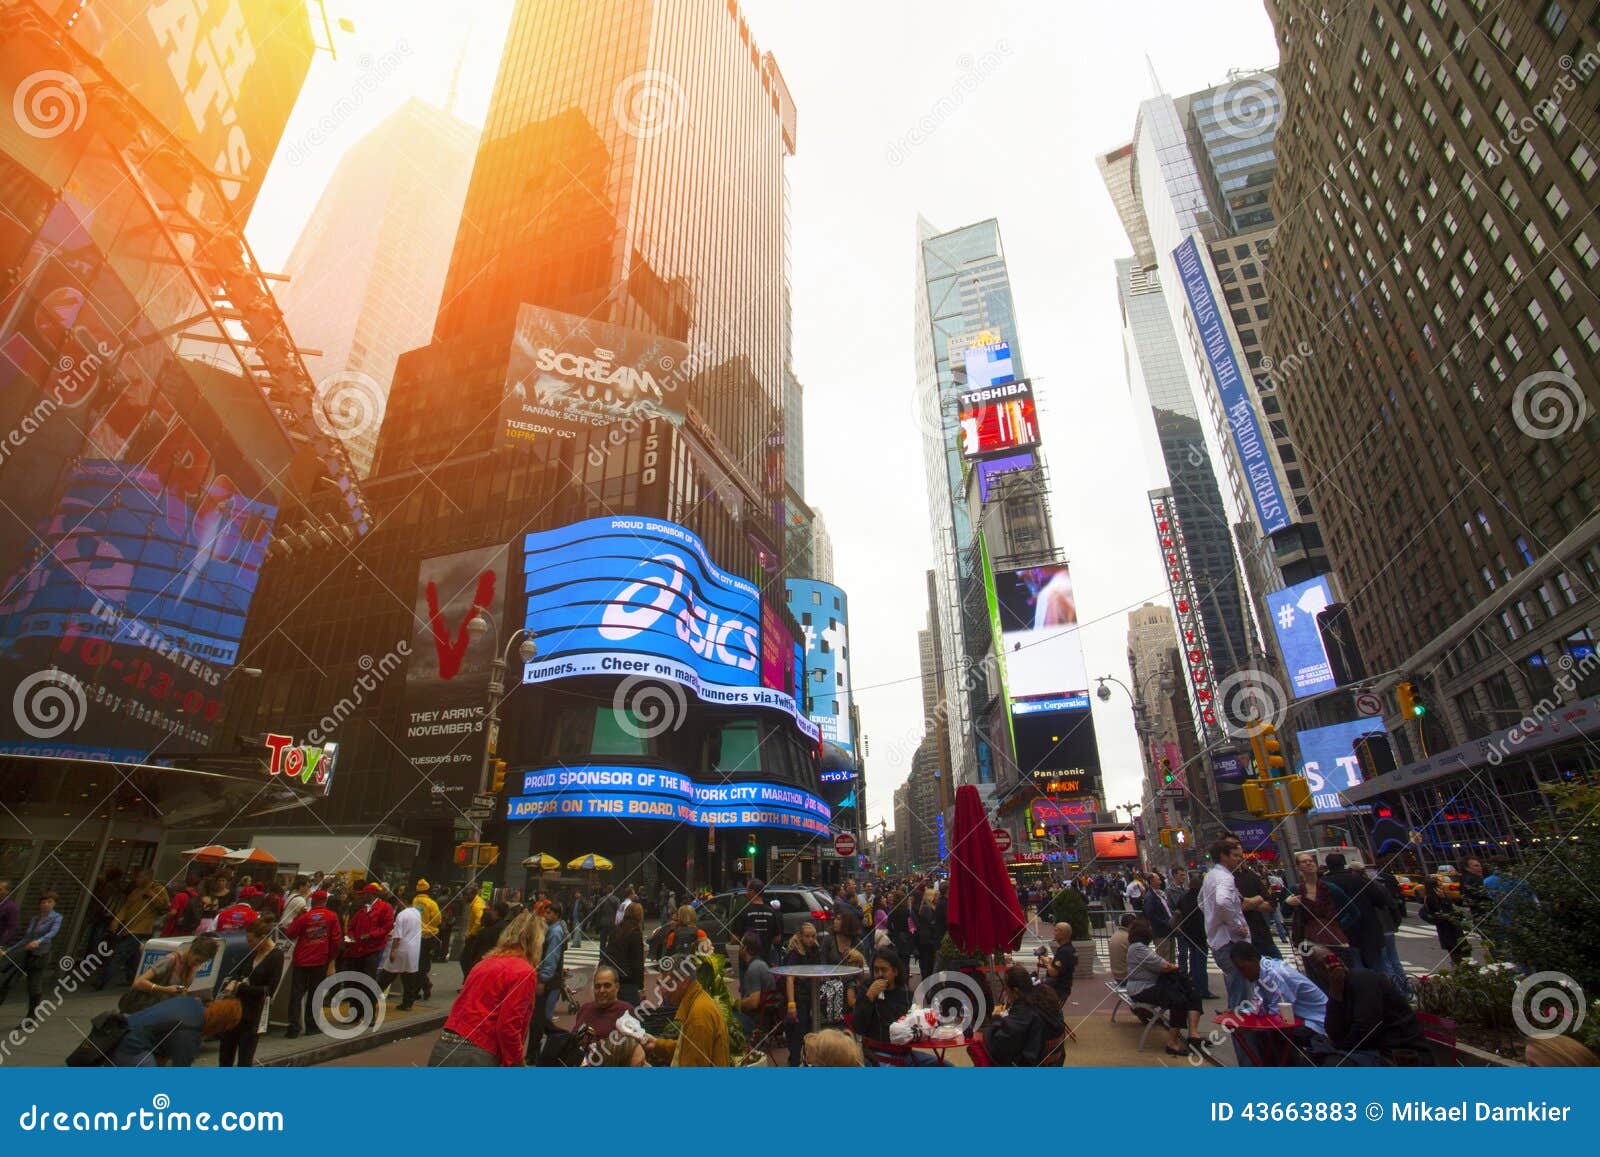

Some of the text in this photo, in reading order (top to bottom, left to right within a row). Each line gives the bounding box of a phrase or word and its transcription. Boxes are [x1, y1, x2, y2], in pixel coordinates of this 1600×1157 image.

[536, 348, 664, 399] SCREAM
[961, 383, 1028, 404] TOSHIBA
[506, 429, 535, 441] 10PM
[507, 420, 554, 434] TUESDAY
[642, 418, 658, 486] 1500
[612, 520, 644, 530] PROUD
[646, 522, 684, 540] SPONSOR
[425, 569, 496, 680] V
[528, 662, 576, 679] runners.
[601, 657, 650, 672] Cheer
[654, 664, 671, 676] on
[702, 686, 748, 702] runners
[754, 691, 771, 703] via
[1044, 699, 1087, 710] Corporation
[410, 711, 440, 723] THEY
[408, 721, 483, 737] NOVEMBER 3
[410, 754, 450, 765] TUESDAYS
[524, 773, 556, 789] PROUD
[560, 772, 632, 786] SPONSOR
[638, 773, 656, 786] OF
[659, 775, 678, 789] THE
[695, 789, 727, 801] YORK
[731, 788, 757, 799] CITY
[761, 788, 803, 805] MARATHON
[515, 801, 557, 815] APPEAR
[562, 799, 582, 813] ON
[588, 799, 623, 812] THIS
[701, 811, 737, 823] ASICS
[741, 811, 778, 824] BOOTH
